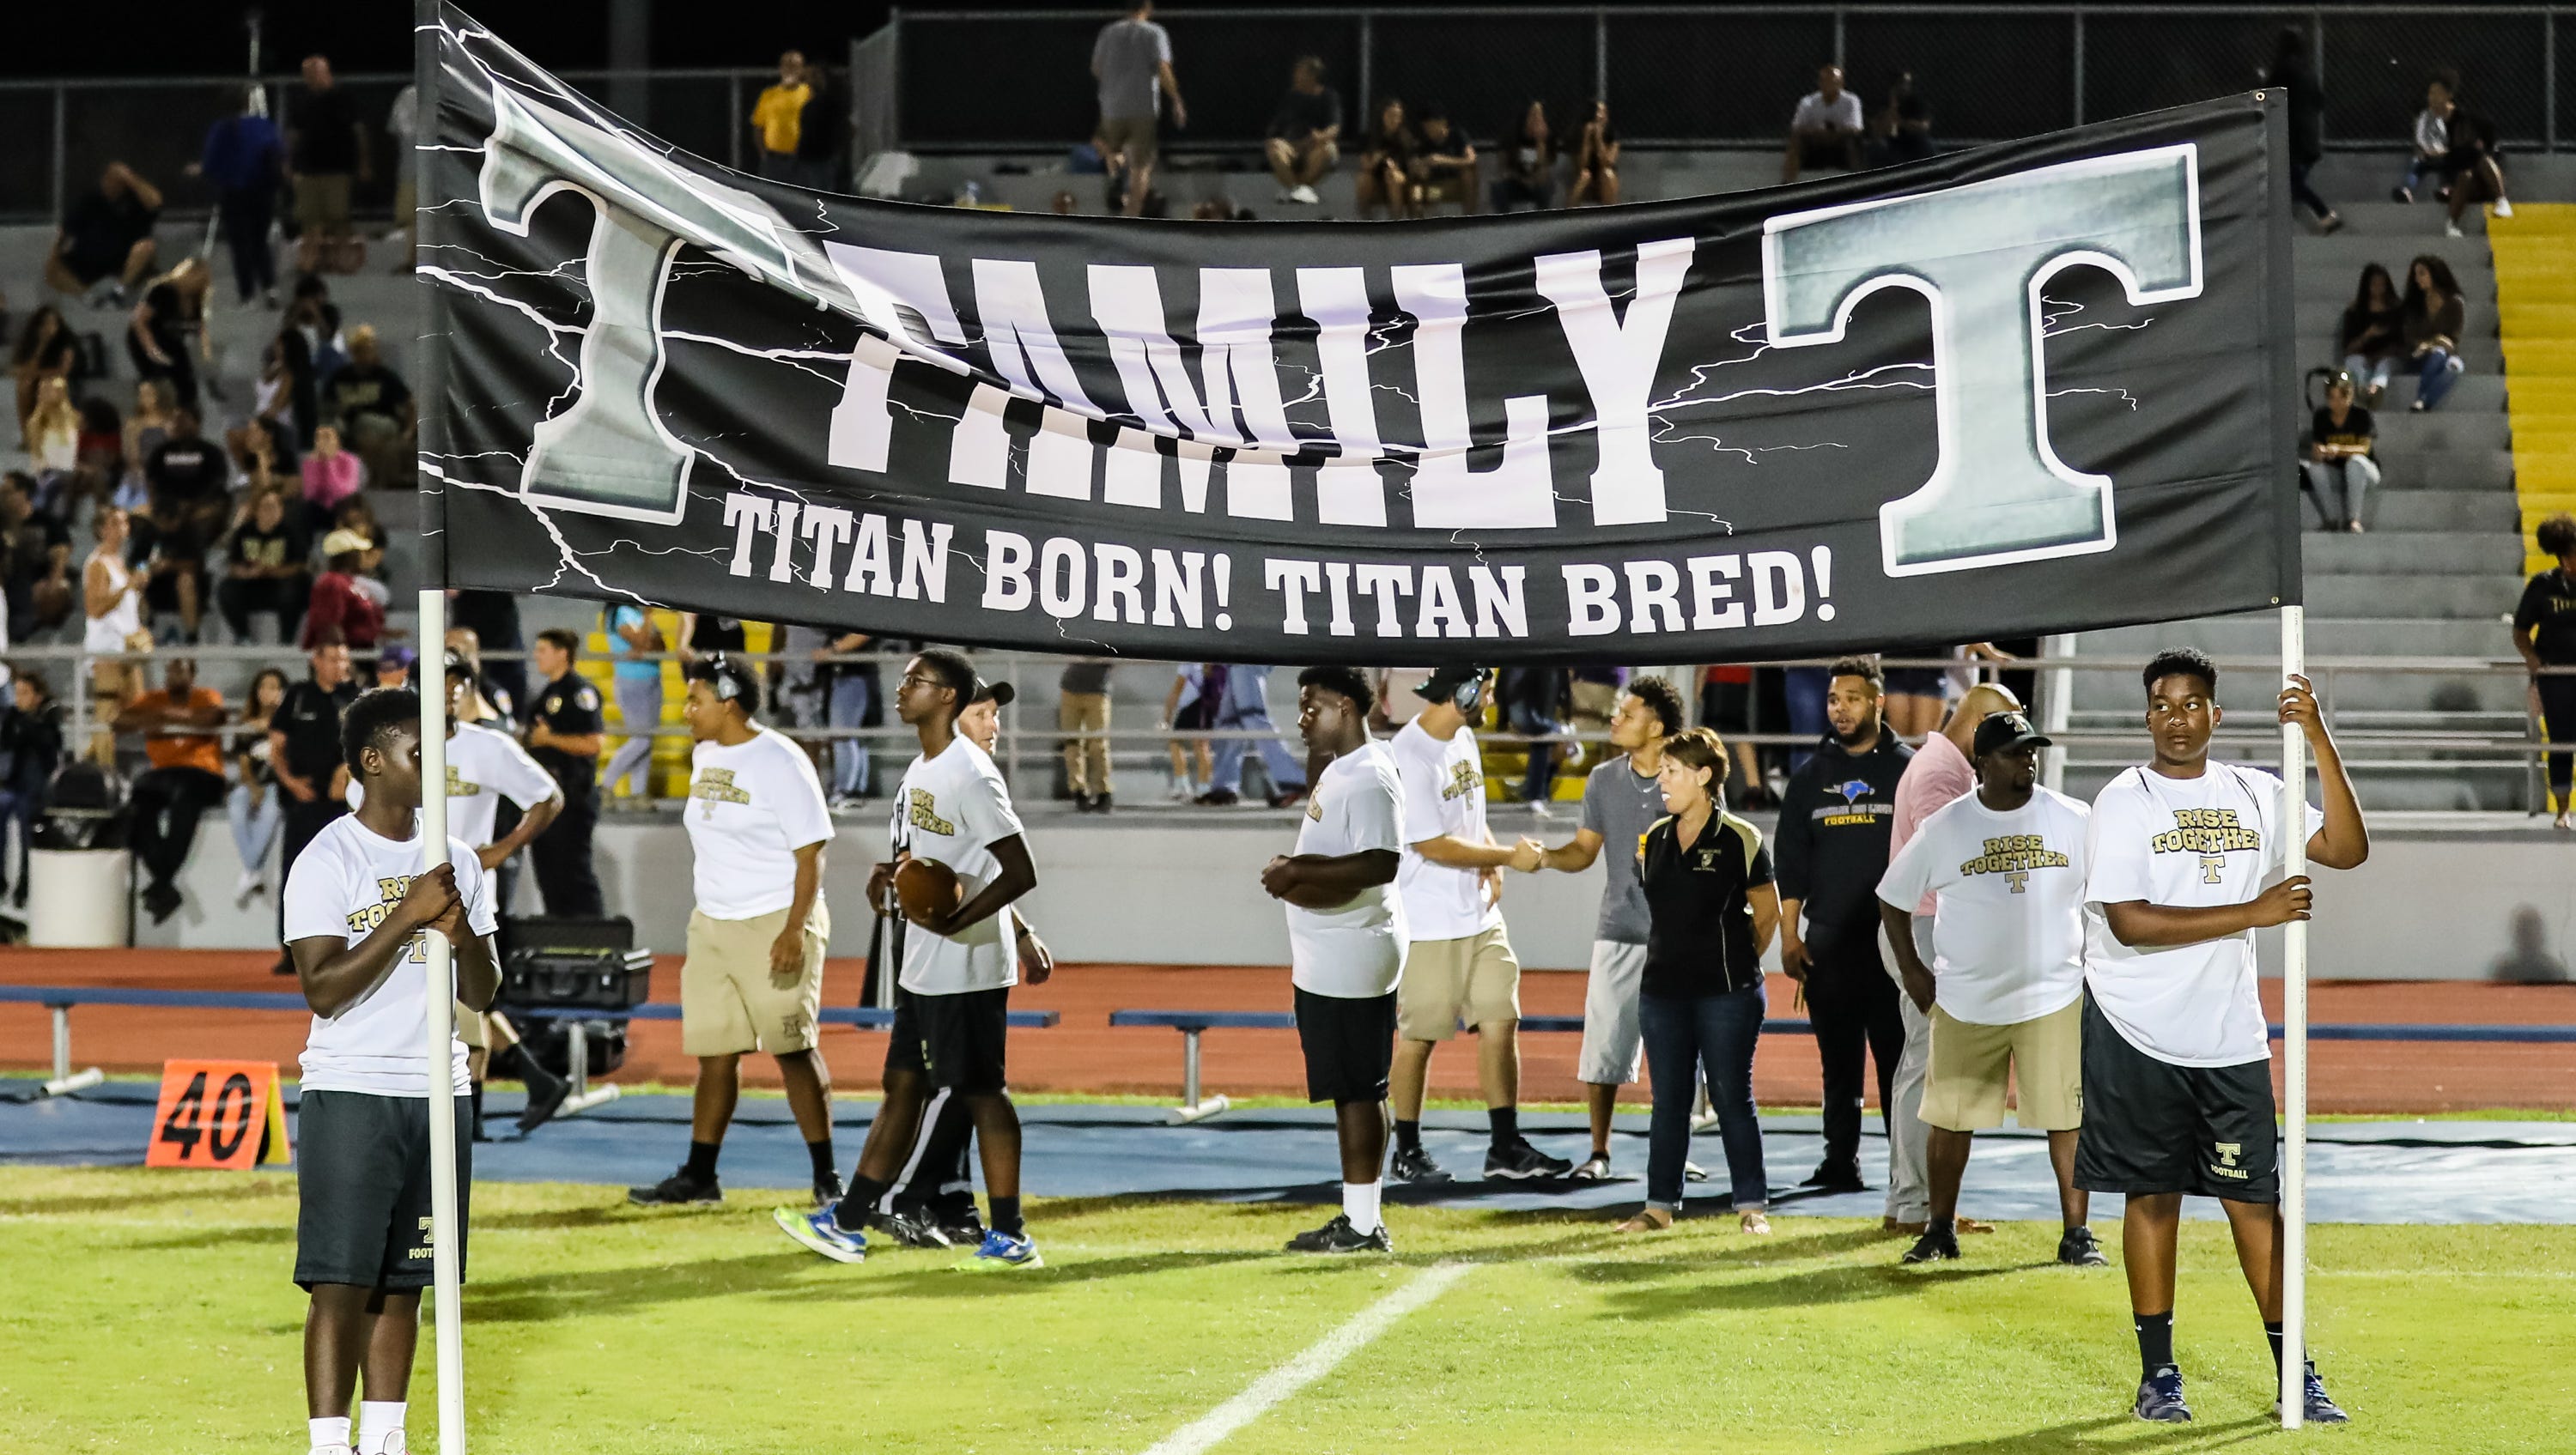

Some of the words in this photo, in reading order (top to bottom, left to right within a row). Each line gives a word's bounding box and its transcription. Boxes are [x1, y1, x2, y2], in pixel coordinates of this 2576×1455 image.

[477, 77, 829, 525] T
[822, 236, 1696, 529] FAMILY
[1762, 142, 2204, 578] T
[723, 492, 954, 603] TITAN
[981, 529, 1232, 632] BORN!
[1264, 557, 1528, 638] TITAN
[1561, 545, 1836, 637] BRED!
[2173, 808, 2240, 829] RISE
[1983, 834, 2044, 857] RISE
[1960, 851, 2069, 876] TOGETHER
[2199, 855, 2226, 884] T
[378, 875, 424, 903] RI
[2004, 872, 2029, 894] T
[160, 1070, 252, 1161] 40
[2215, 1142, 2241, 1166] T
[2210, 1163, 2249, 1179] FOOTBALL
[408, 1247, 434, 1260] FOOT
